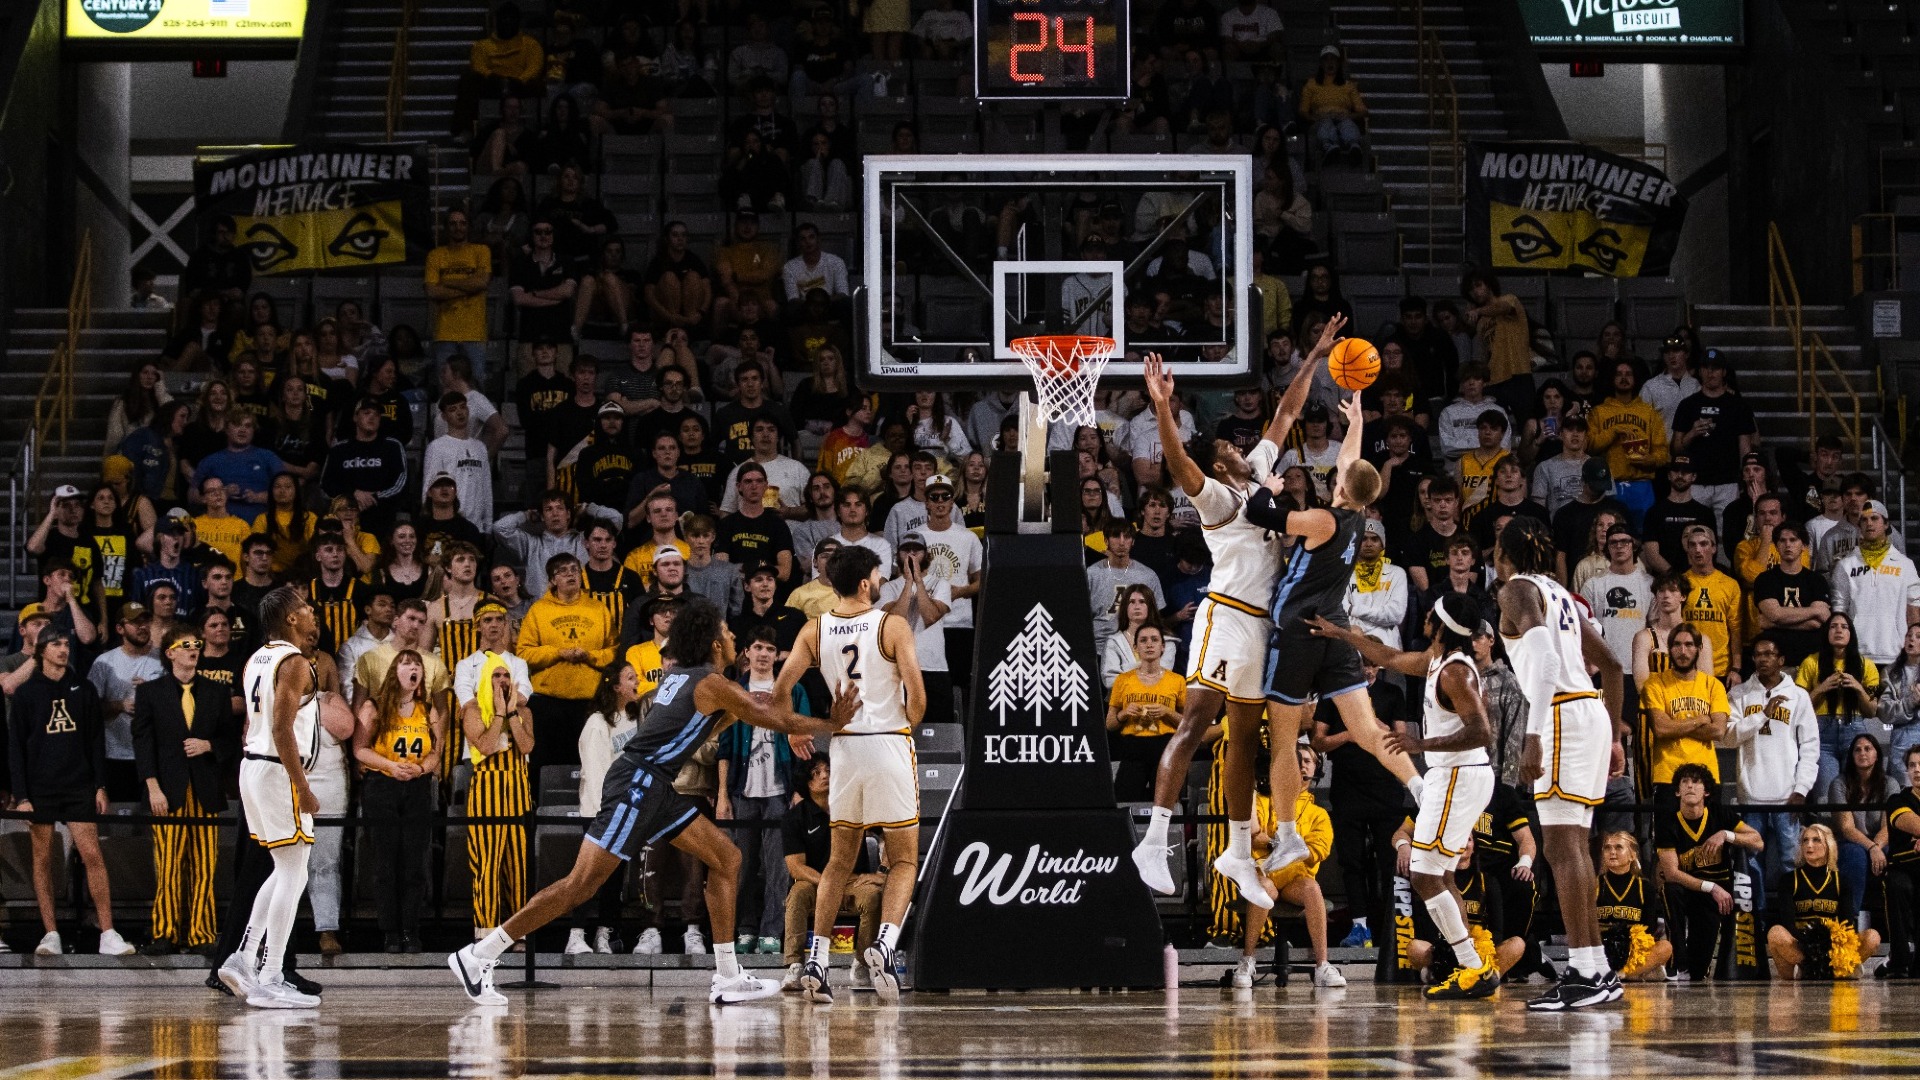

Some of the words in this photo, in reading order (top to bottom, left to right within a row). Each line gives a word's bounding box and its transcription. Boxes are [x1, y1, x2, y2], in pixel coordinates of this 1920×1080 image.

[83, 0, 147, 11] CENTURY
[148, 0, 161, 11] 21
[1622, 13, 1671, 25] BISCUIT
[1010, 12, 1095, 82] 24
[210, 153, 414, 197] MOUNTAINEER
[1479, 152, 1677, 208] MOUNTAINEER
[253, 180, 382, 218] MENACE
[1520, 182, 1641, 220] MENACE
[880, 366, 919, 375] SPALDING
[342, 456, 382, 469] adidas
[690, 463, 717, 474] STATE
[1850, 565, 1872, 578] APP
[1696, 586, 1713, 609] A
[829, 622, 870, 636] MANTIS
[1685, 612, 1724, 623] BASEBALL
[646, 668, 663, 683] APP
[841, 643, 862, 680] 2
[1211, 659, 1228, 681] A
[251, 675, 262, 713] 4
[46, 698, 78, 734] A
[393, 736, 424, 759] 44
[984, 734, 1096, 764] ECHOTA
[953, 841, 1119, 906] Window
[1393, 875, 1413, 917] APP
[1733, 870, 1753, 913] APP
[1735, 912, 1756, 966] STATE
